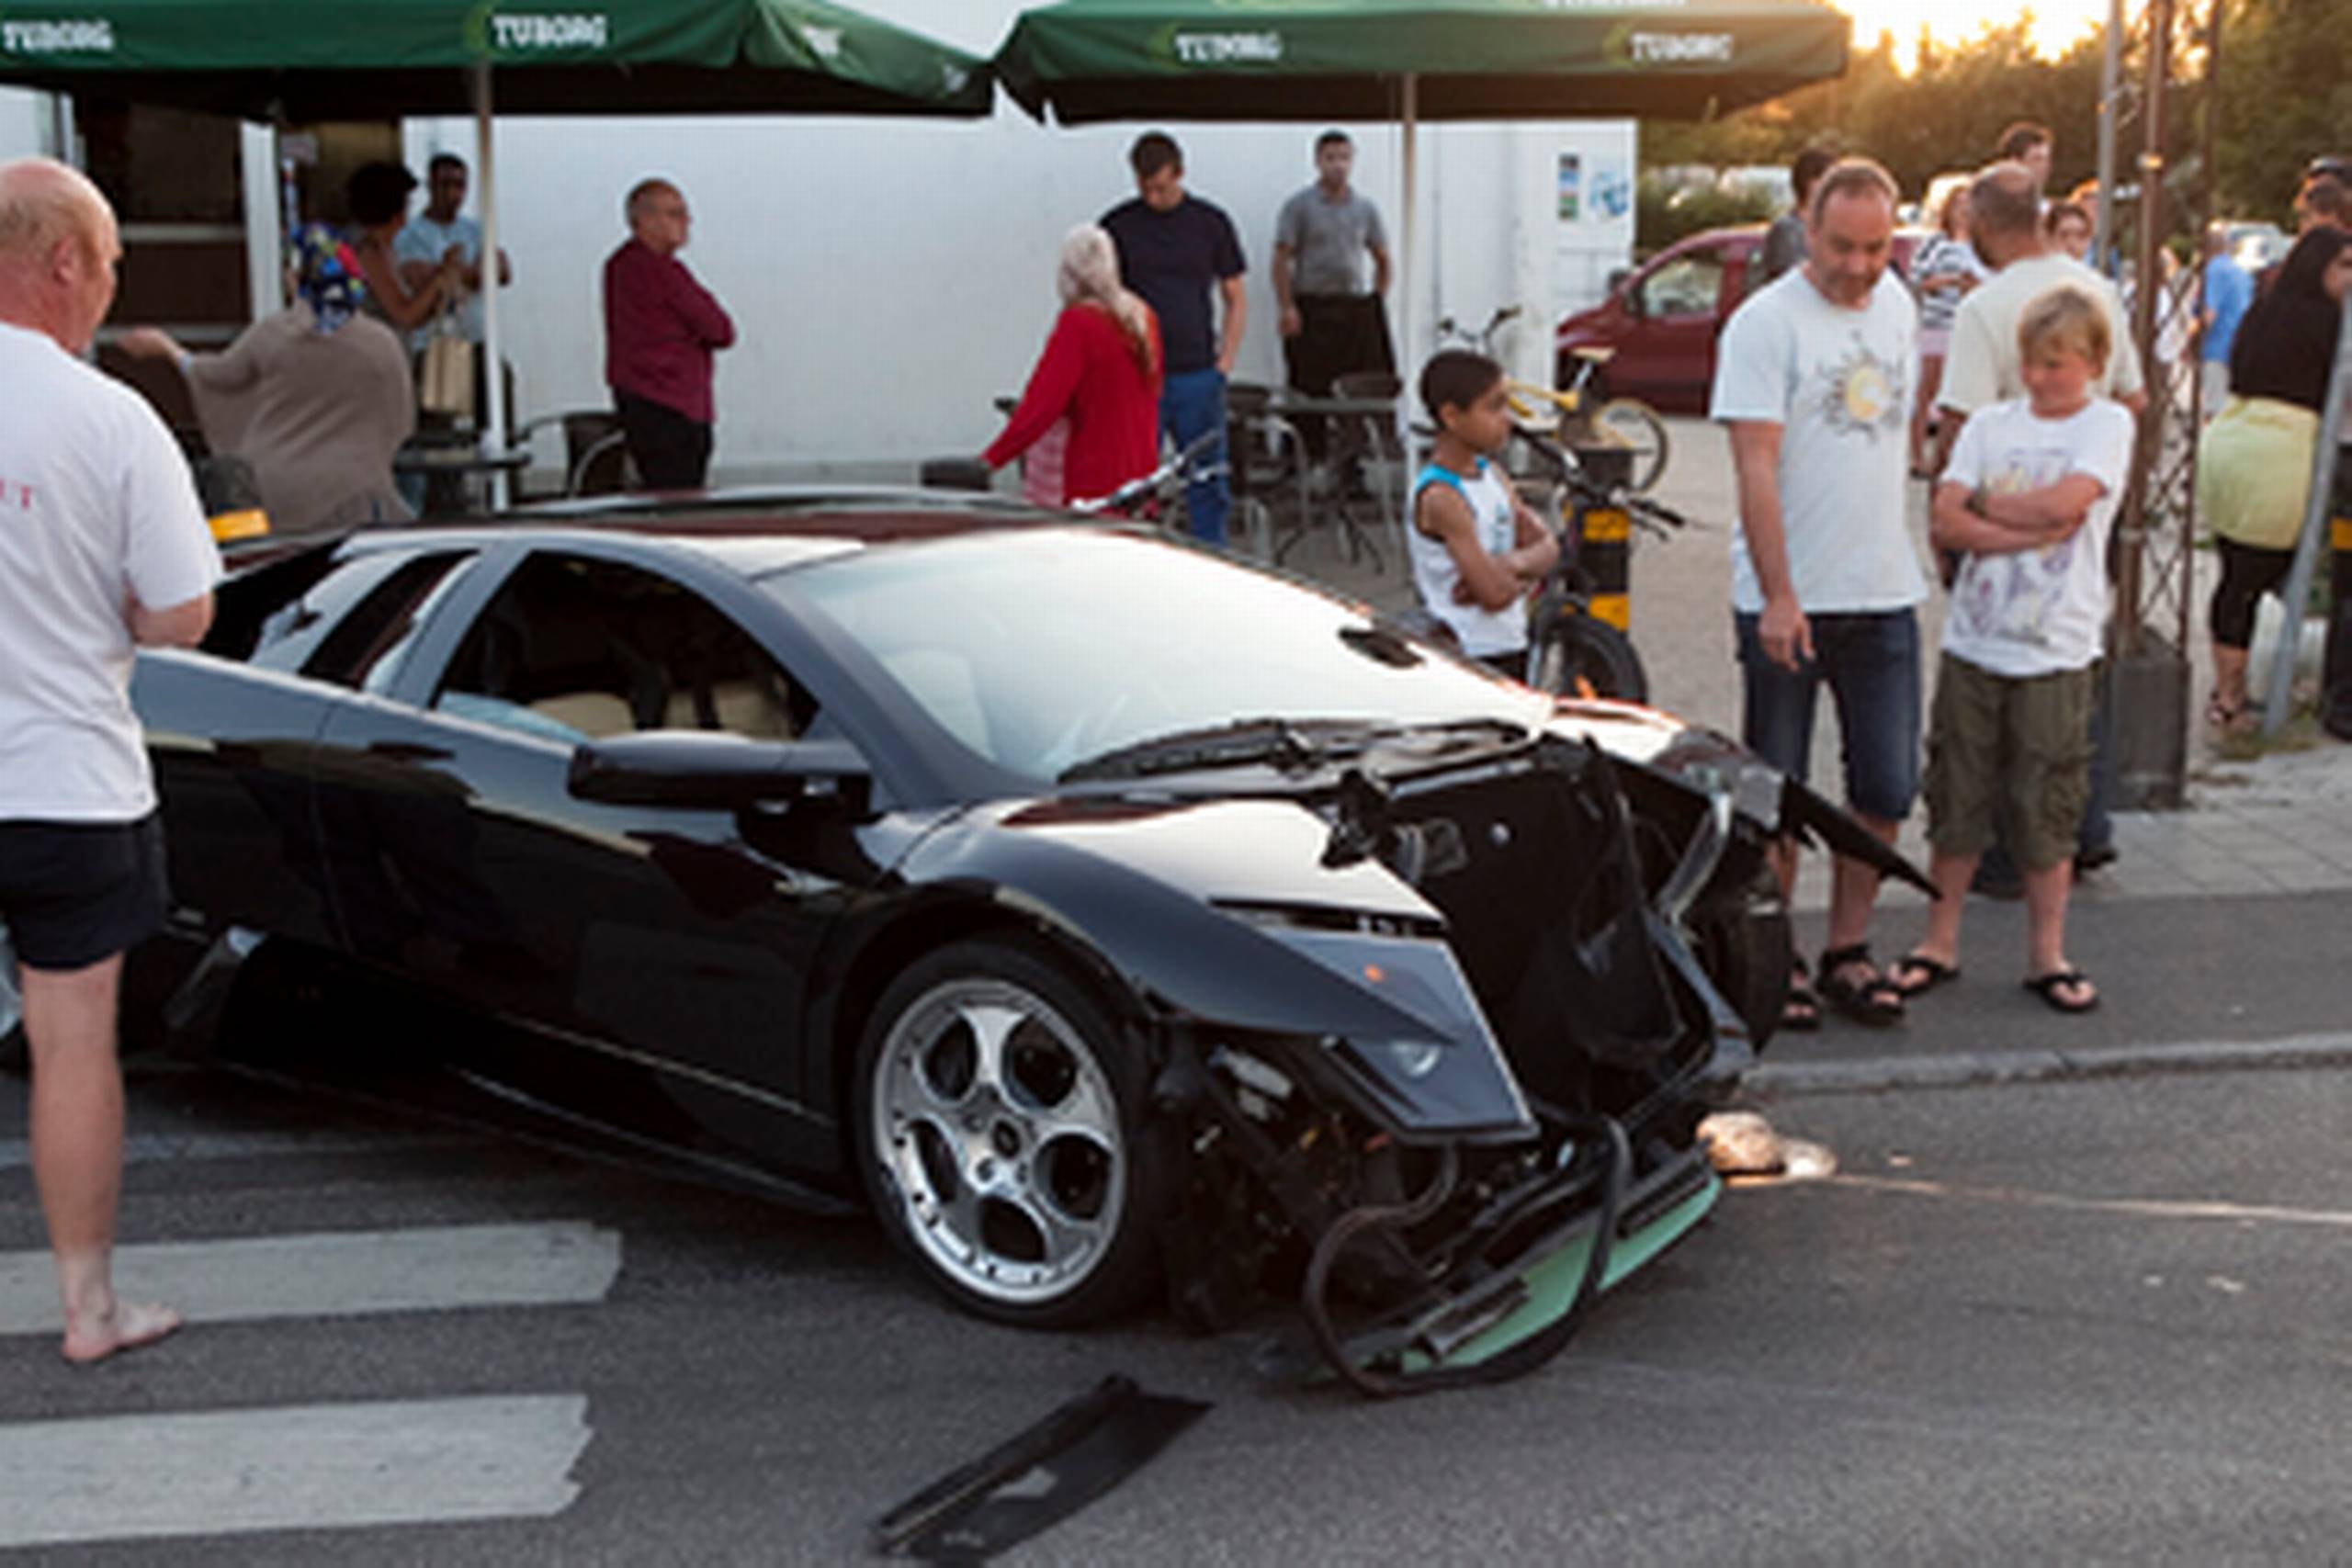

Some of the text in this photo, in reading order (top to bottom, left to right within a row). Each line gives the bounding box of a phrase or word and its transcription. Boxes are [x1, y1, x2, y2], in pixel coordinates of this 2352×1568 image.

[3, 19, 113, 52] TUBORG
[493, 14, 607, 47] TUBORG
[1175, 31, 1283, 62] TUBORG
[1631, 32, 1734, 62] TUBORG
